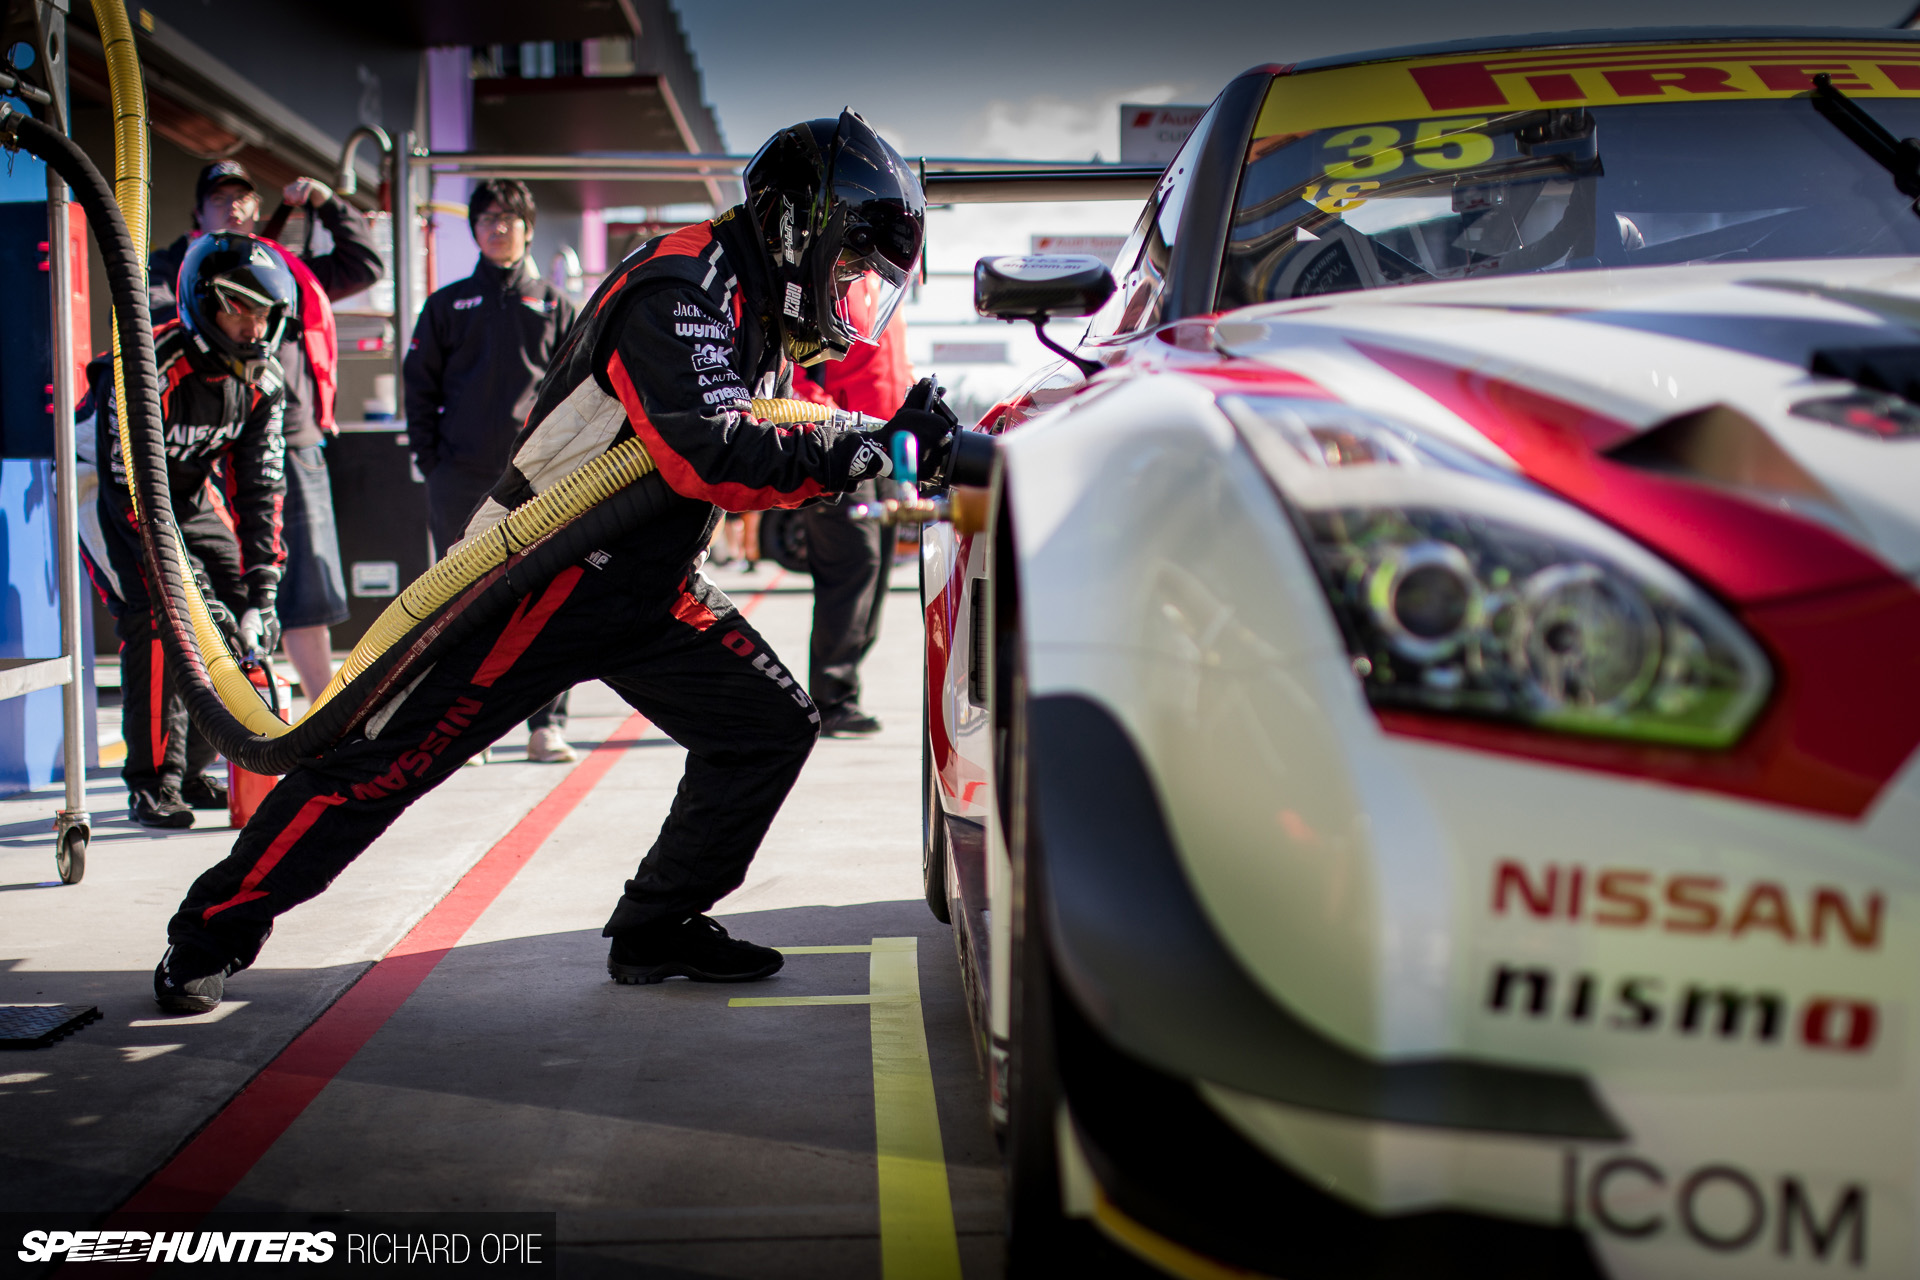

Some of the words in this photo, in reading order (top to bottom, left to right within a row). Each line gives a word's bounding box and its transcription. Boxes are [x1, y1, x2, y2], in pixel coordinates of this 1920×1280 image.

[1323, 118, 1494, 179] 35
[673, 301, 701, 318] JACK
[694, 343, 733, 367] GK
[721, 629, 821, 726] ismo
[350, 696, 484, 800] NISSAN
[1492, 857, 1887, 951] NISSAN
[1563, 1151, 1868, 1268] ICOM
